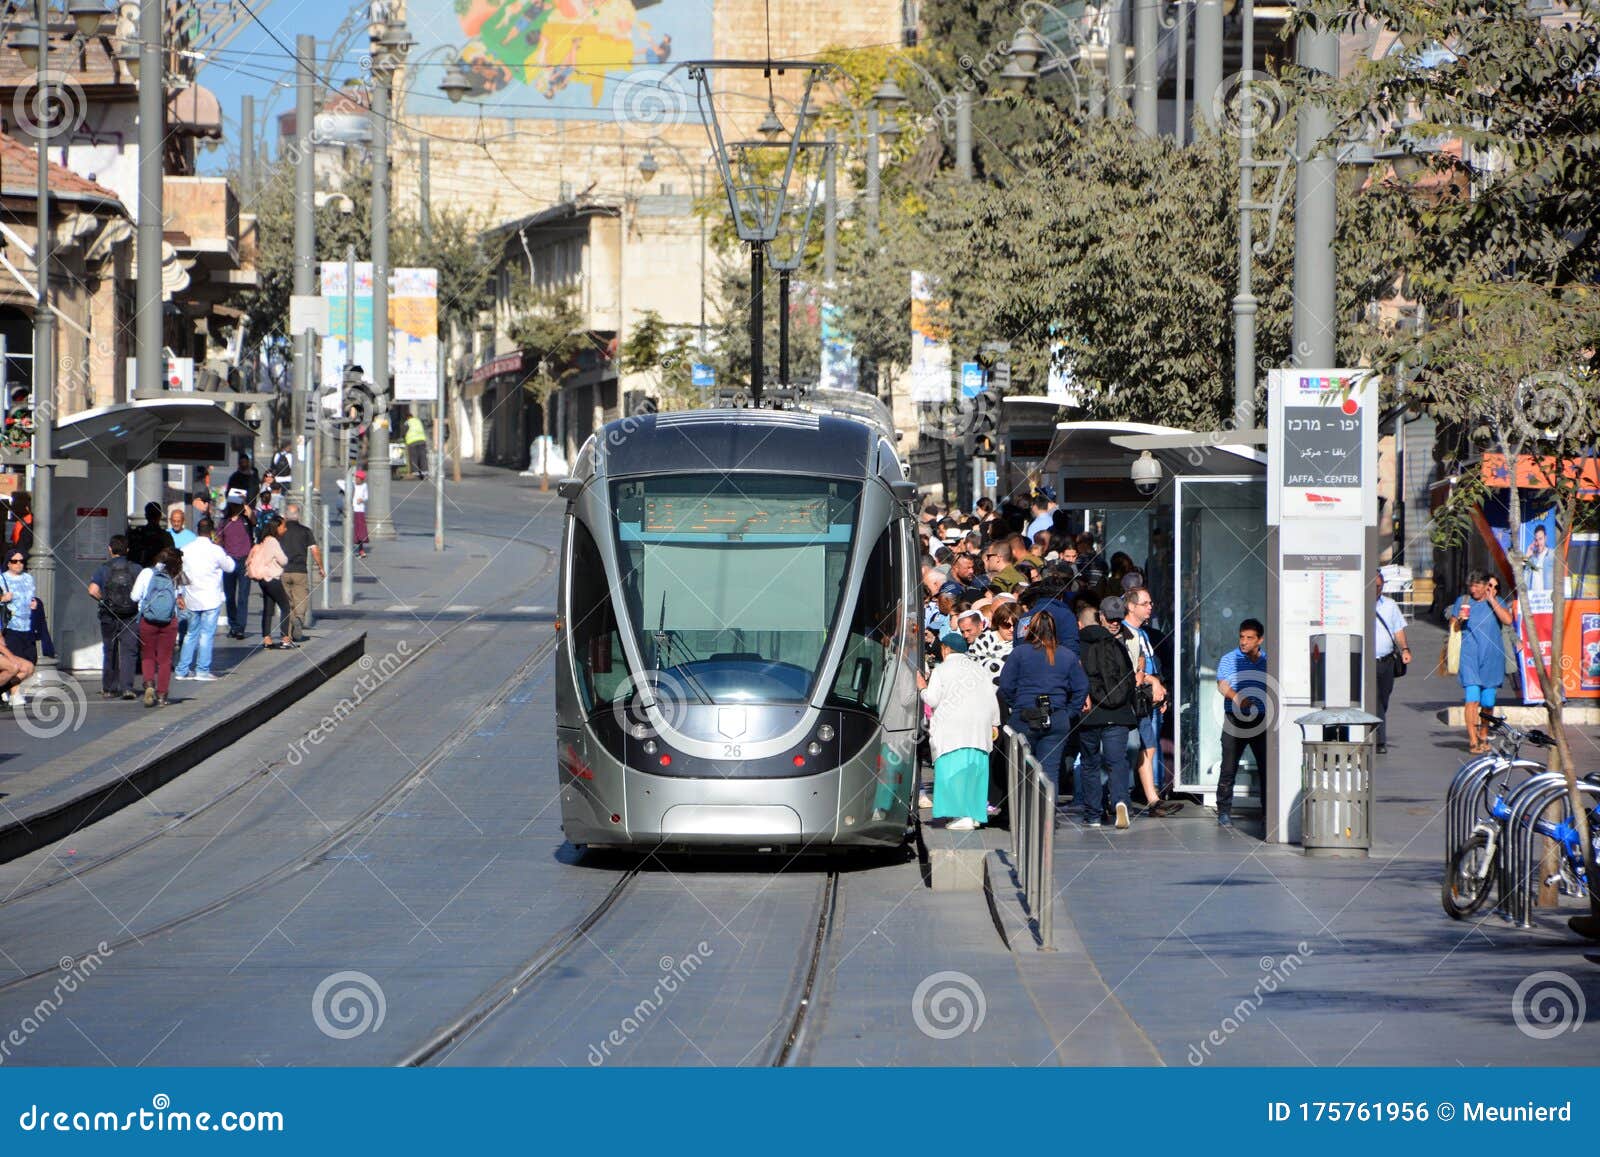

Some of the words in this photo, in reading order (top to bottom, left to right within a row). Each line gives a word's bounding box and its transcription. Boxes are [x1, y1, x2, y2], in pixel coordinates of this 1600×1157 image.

[1287, 419, 1321, 431] מרכז
[1339, 419, 1360, 431] יפו
[1301, 448, 1321, 458] مركز
[1288, 474, 1314, 484] JAFFA
[1324, 474, 1358, 484] CENTER
[724, 744, 742, 758] 26
